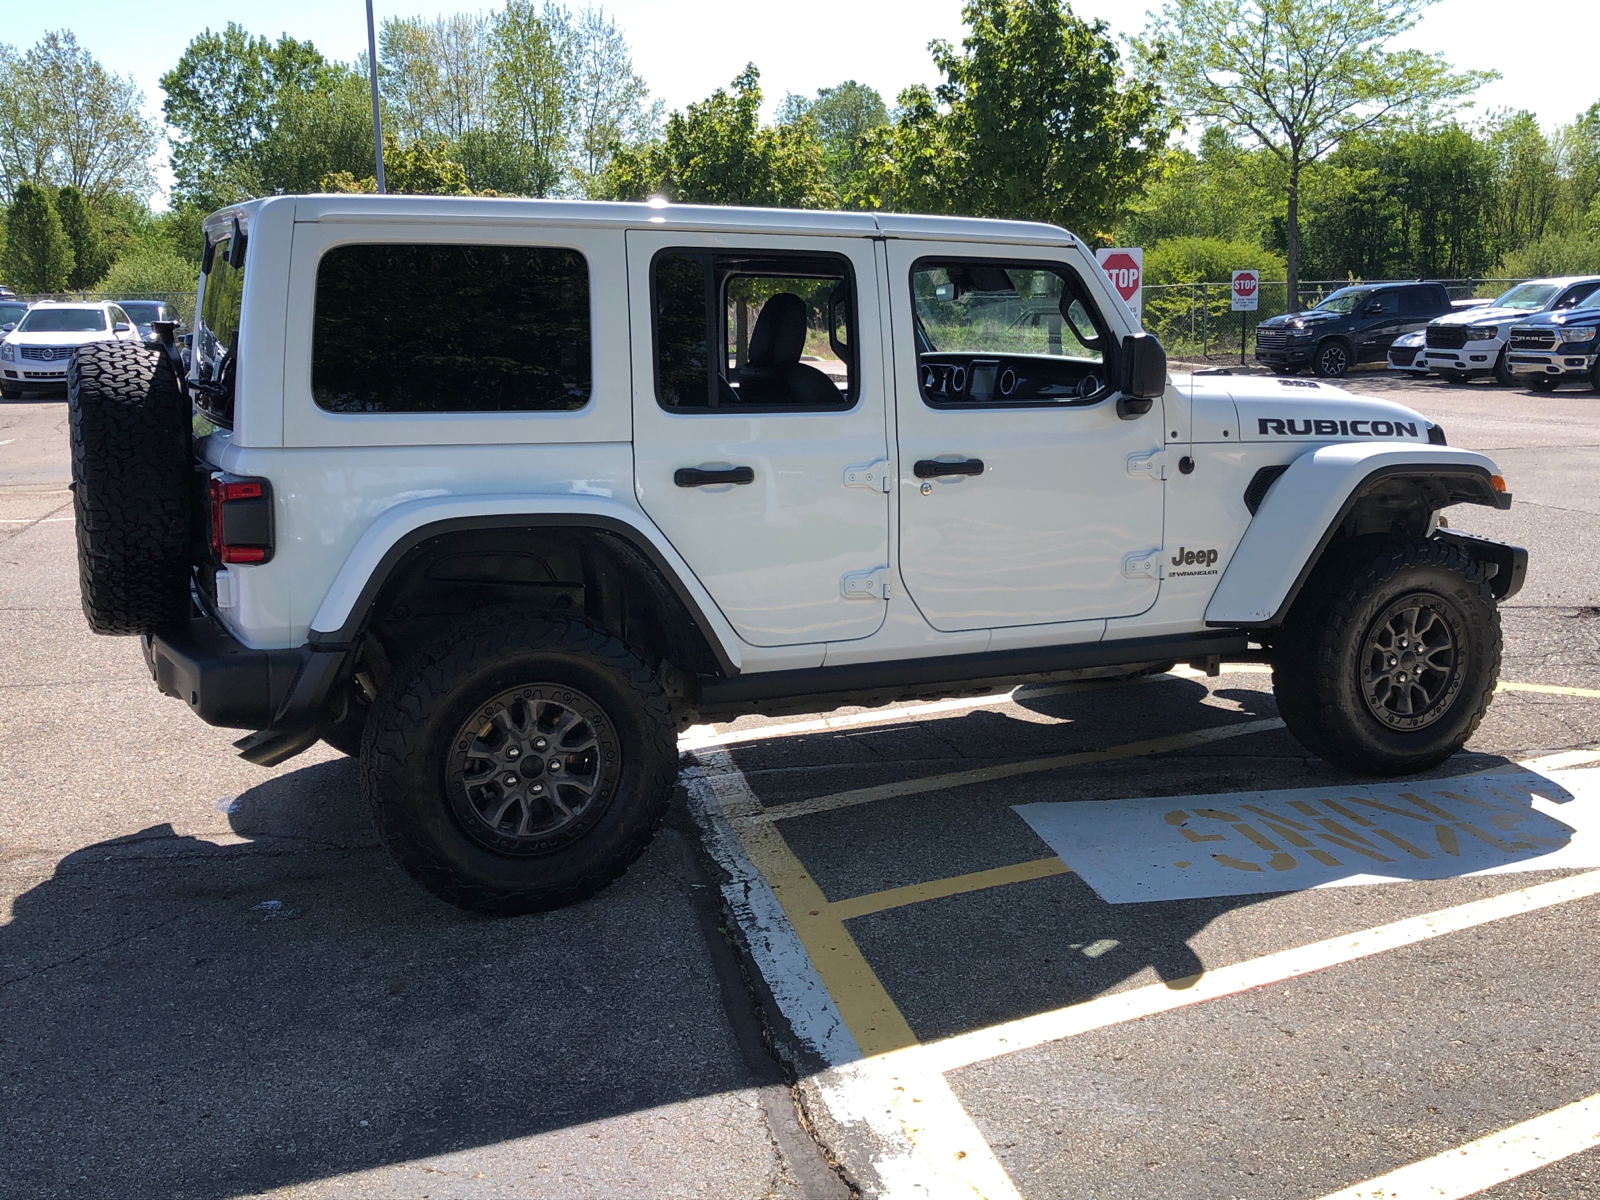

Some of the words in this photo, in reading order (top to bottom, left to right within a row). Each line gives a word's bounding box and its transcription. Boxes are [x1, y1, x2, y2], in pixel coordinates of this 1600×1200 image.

[1104, 268, 1139, 288] TOP
[1234, 280, 1256, 290] STOP
[1257, 418, 1418, 437] RUBICON
[1171, 546, 1218, 568] Jeep
